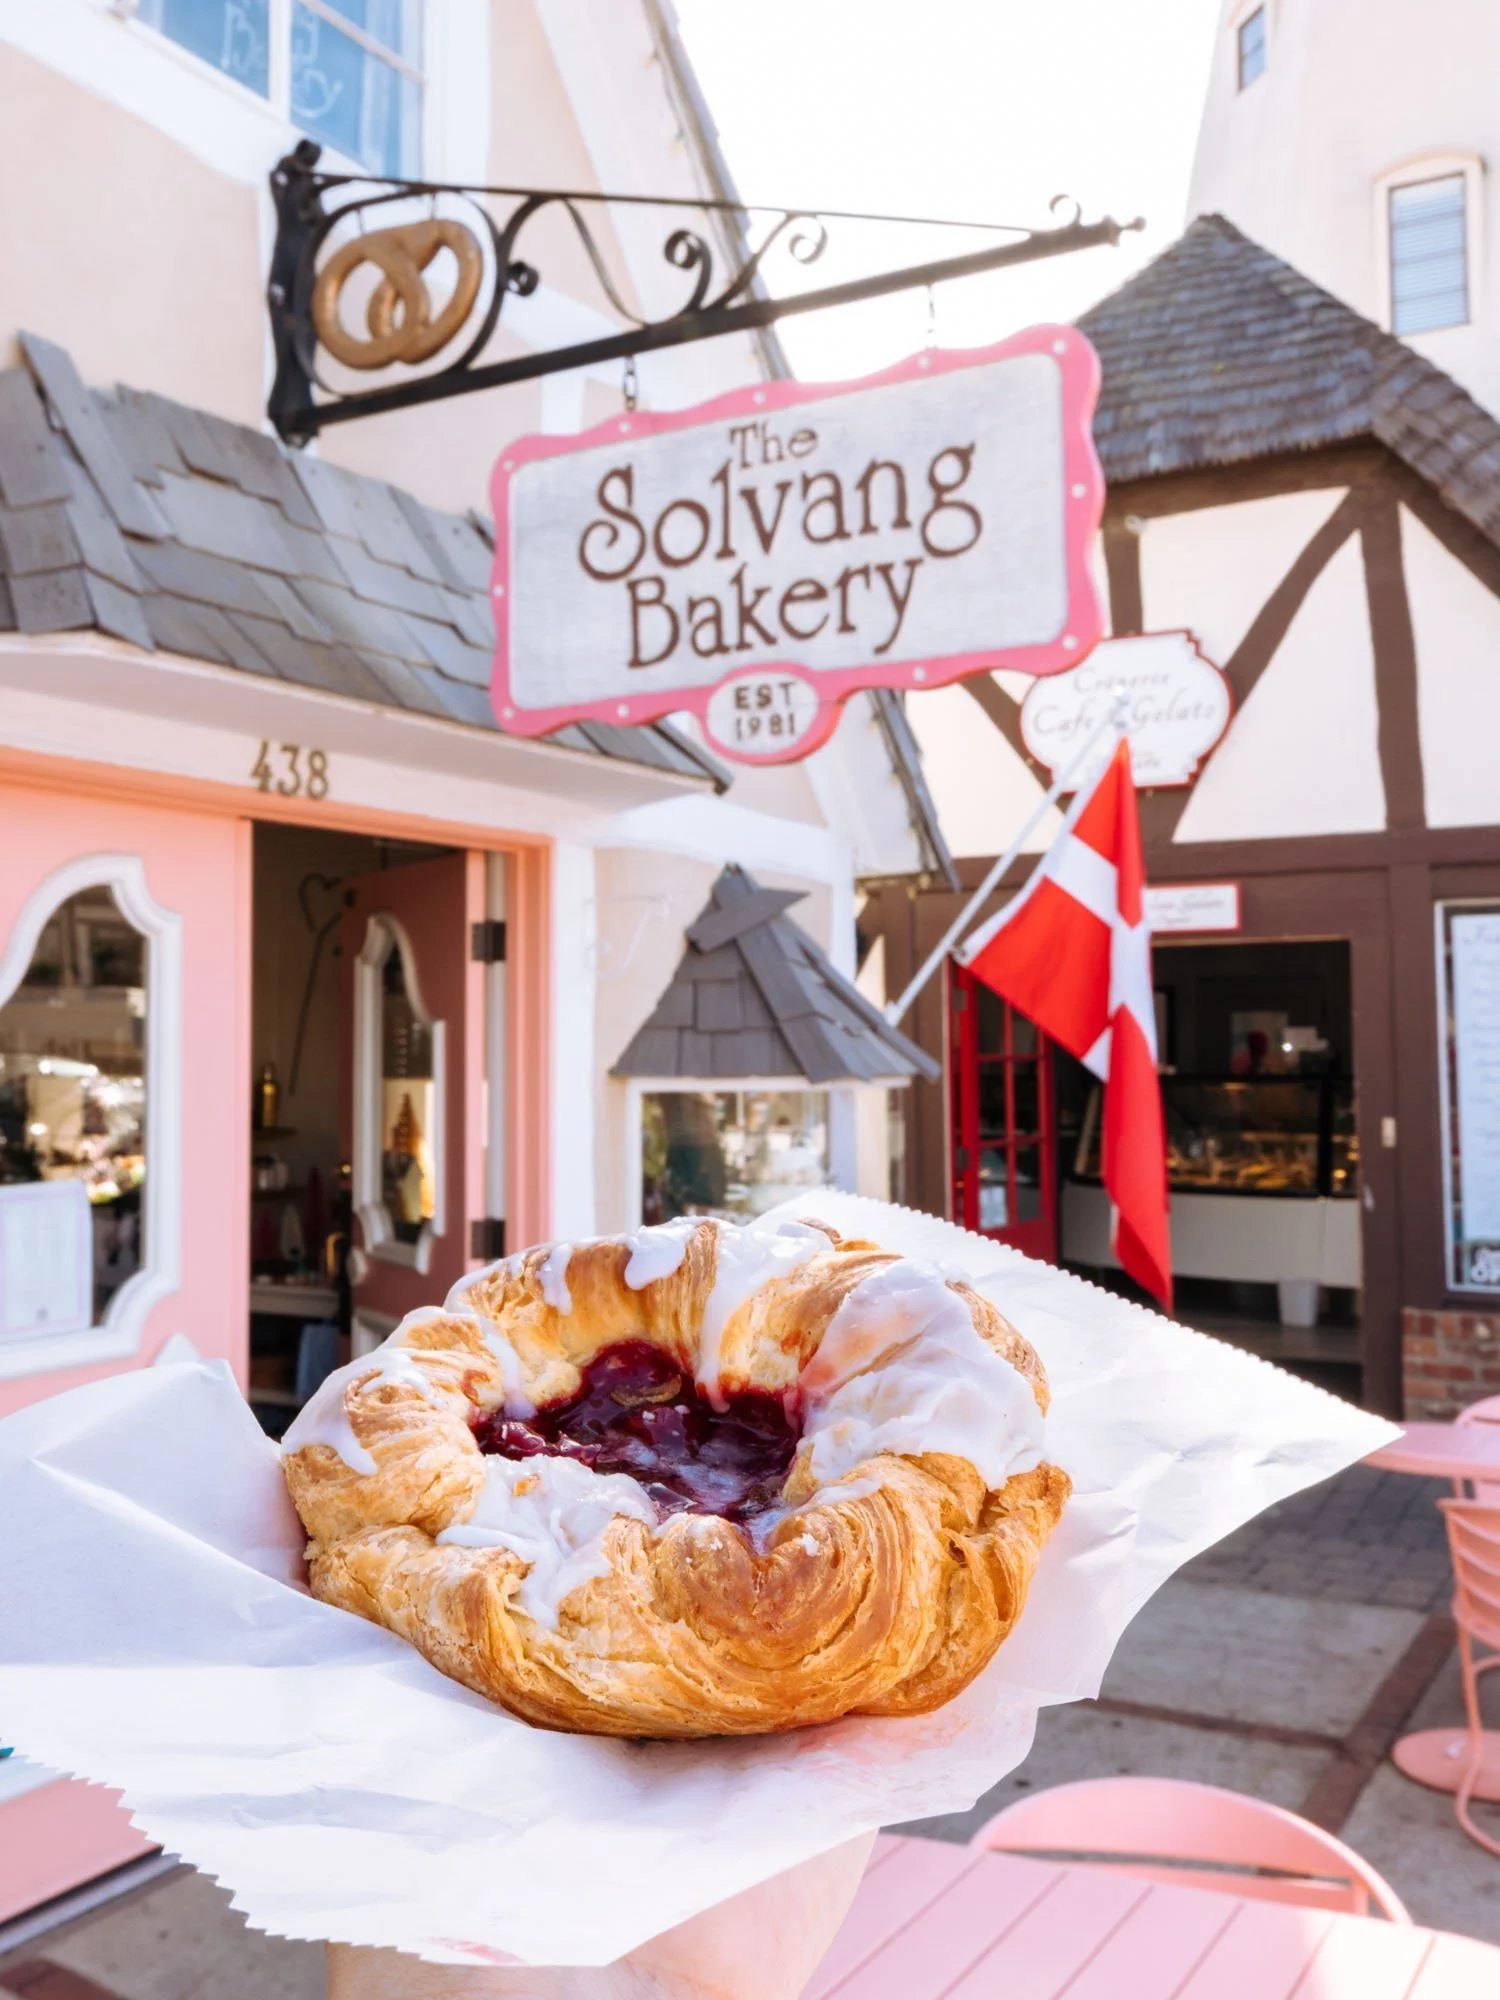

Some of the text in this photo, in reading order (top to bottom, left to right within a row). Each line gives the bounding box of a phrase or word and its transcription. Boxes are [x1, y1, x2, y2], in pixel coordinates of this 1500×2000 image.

[729, 422, 818, 469] The
[578, 443, 983, 582] Solvang
[626, 557, 924, 669] Bakery
[735, 681, 796, 710] EST
[736, 712, 795, 741] 1981
[249, 741, 329, 801] 438
